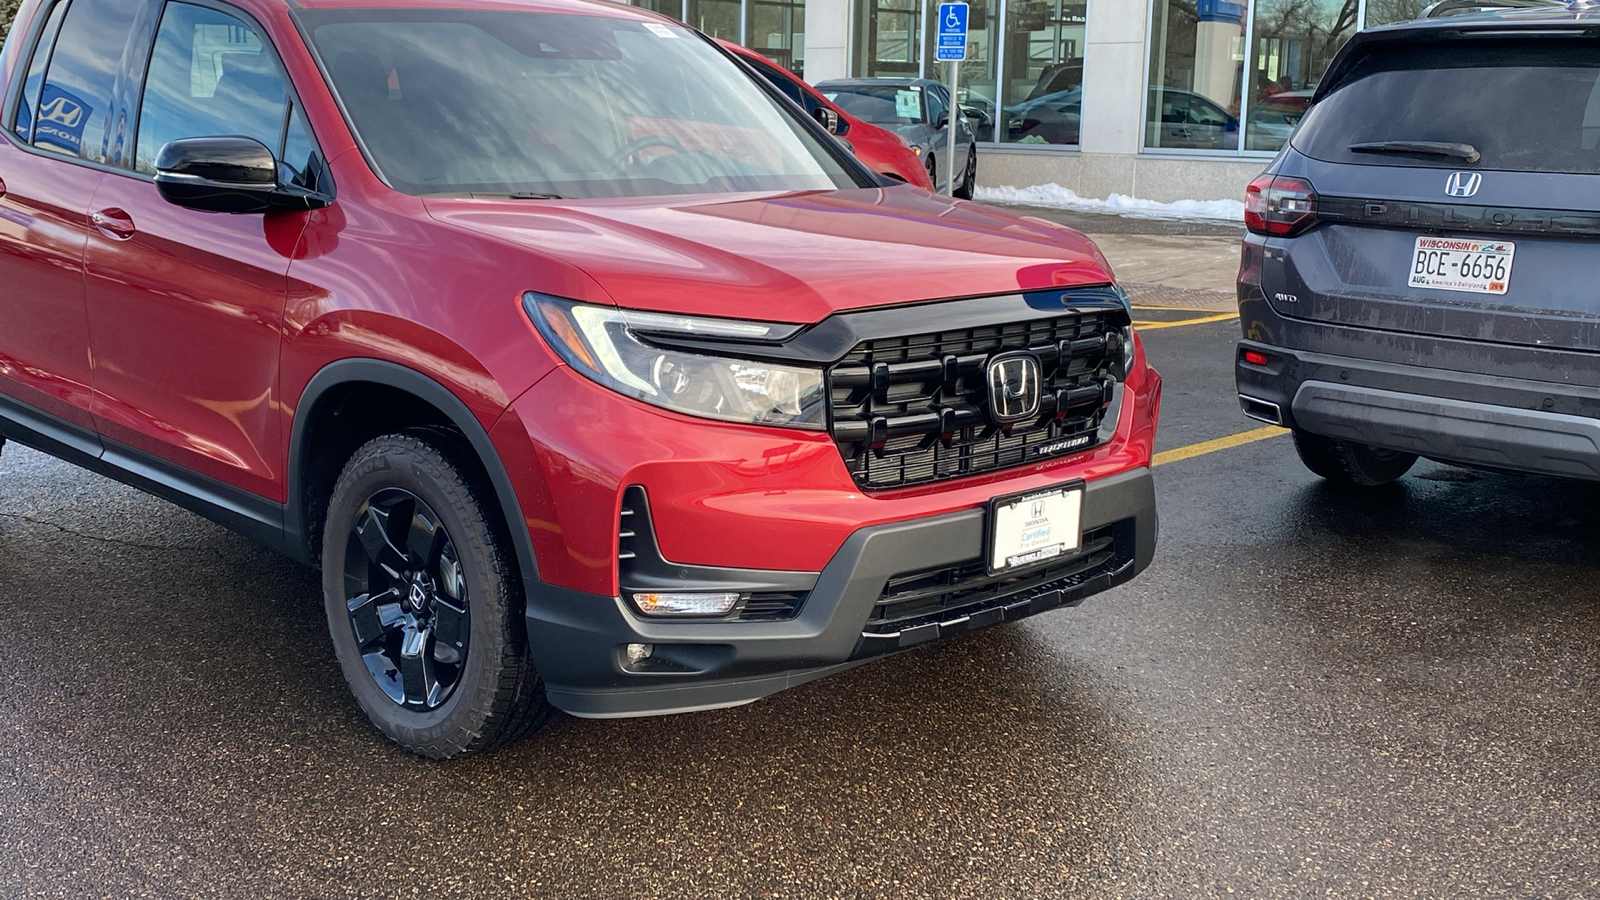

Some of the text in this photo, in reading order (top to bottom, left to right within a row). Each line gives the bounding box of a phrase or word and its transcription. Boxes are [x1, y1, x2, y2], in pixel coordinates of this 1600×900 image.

[1364, 203, 1563, 229] PILOT
[1419, 239, 1472, 250] WISCONSIN
[1414, 250, 1506, 281] BCE-6656
[1411, 275, 1426, 284] AUG
[1025, 517, 1049, 527] HONDA
[1022, 526, 1051, 542] Certified
